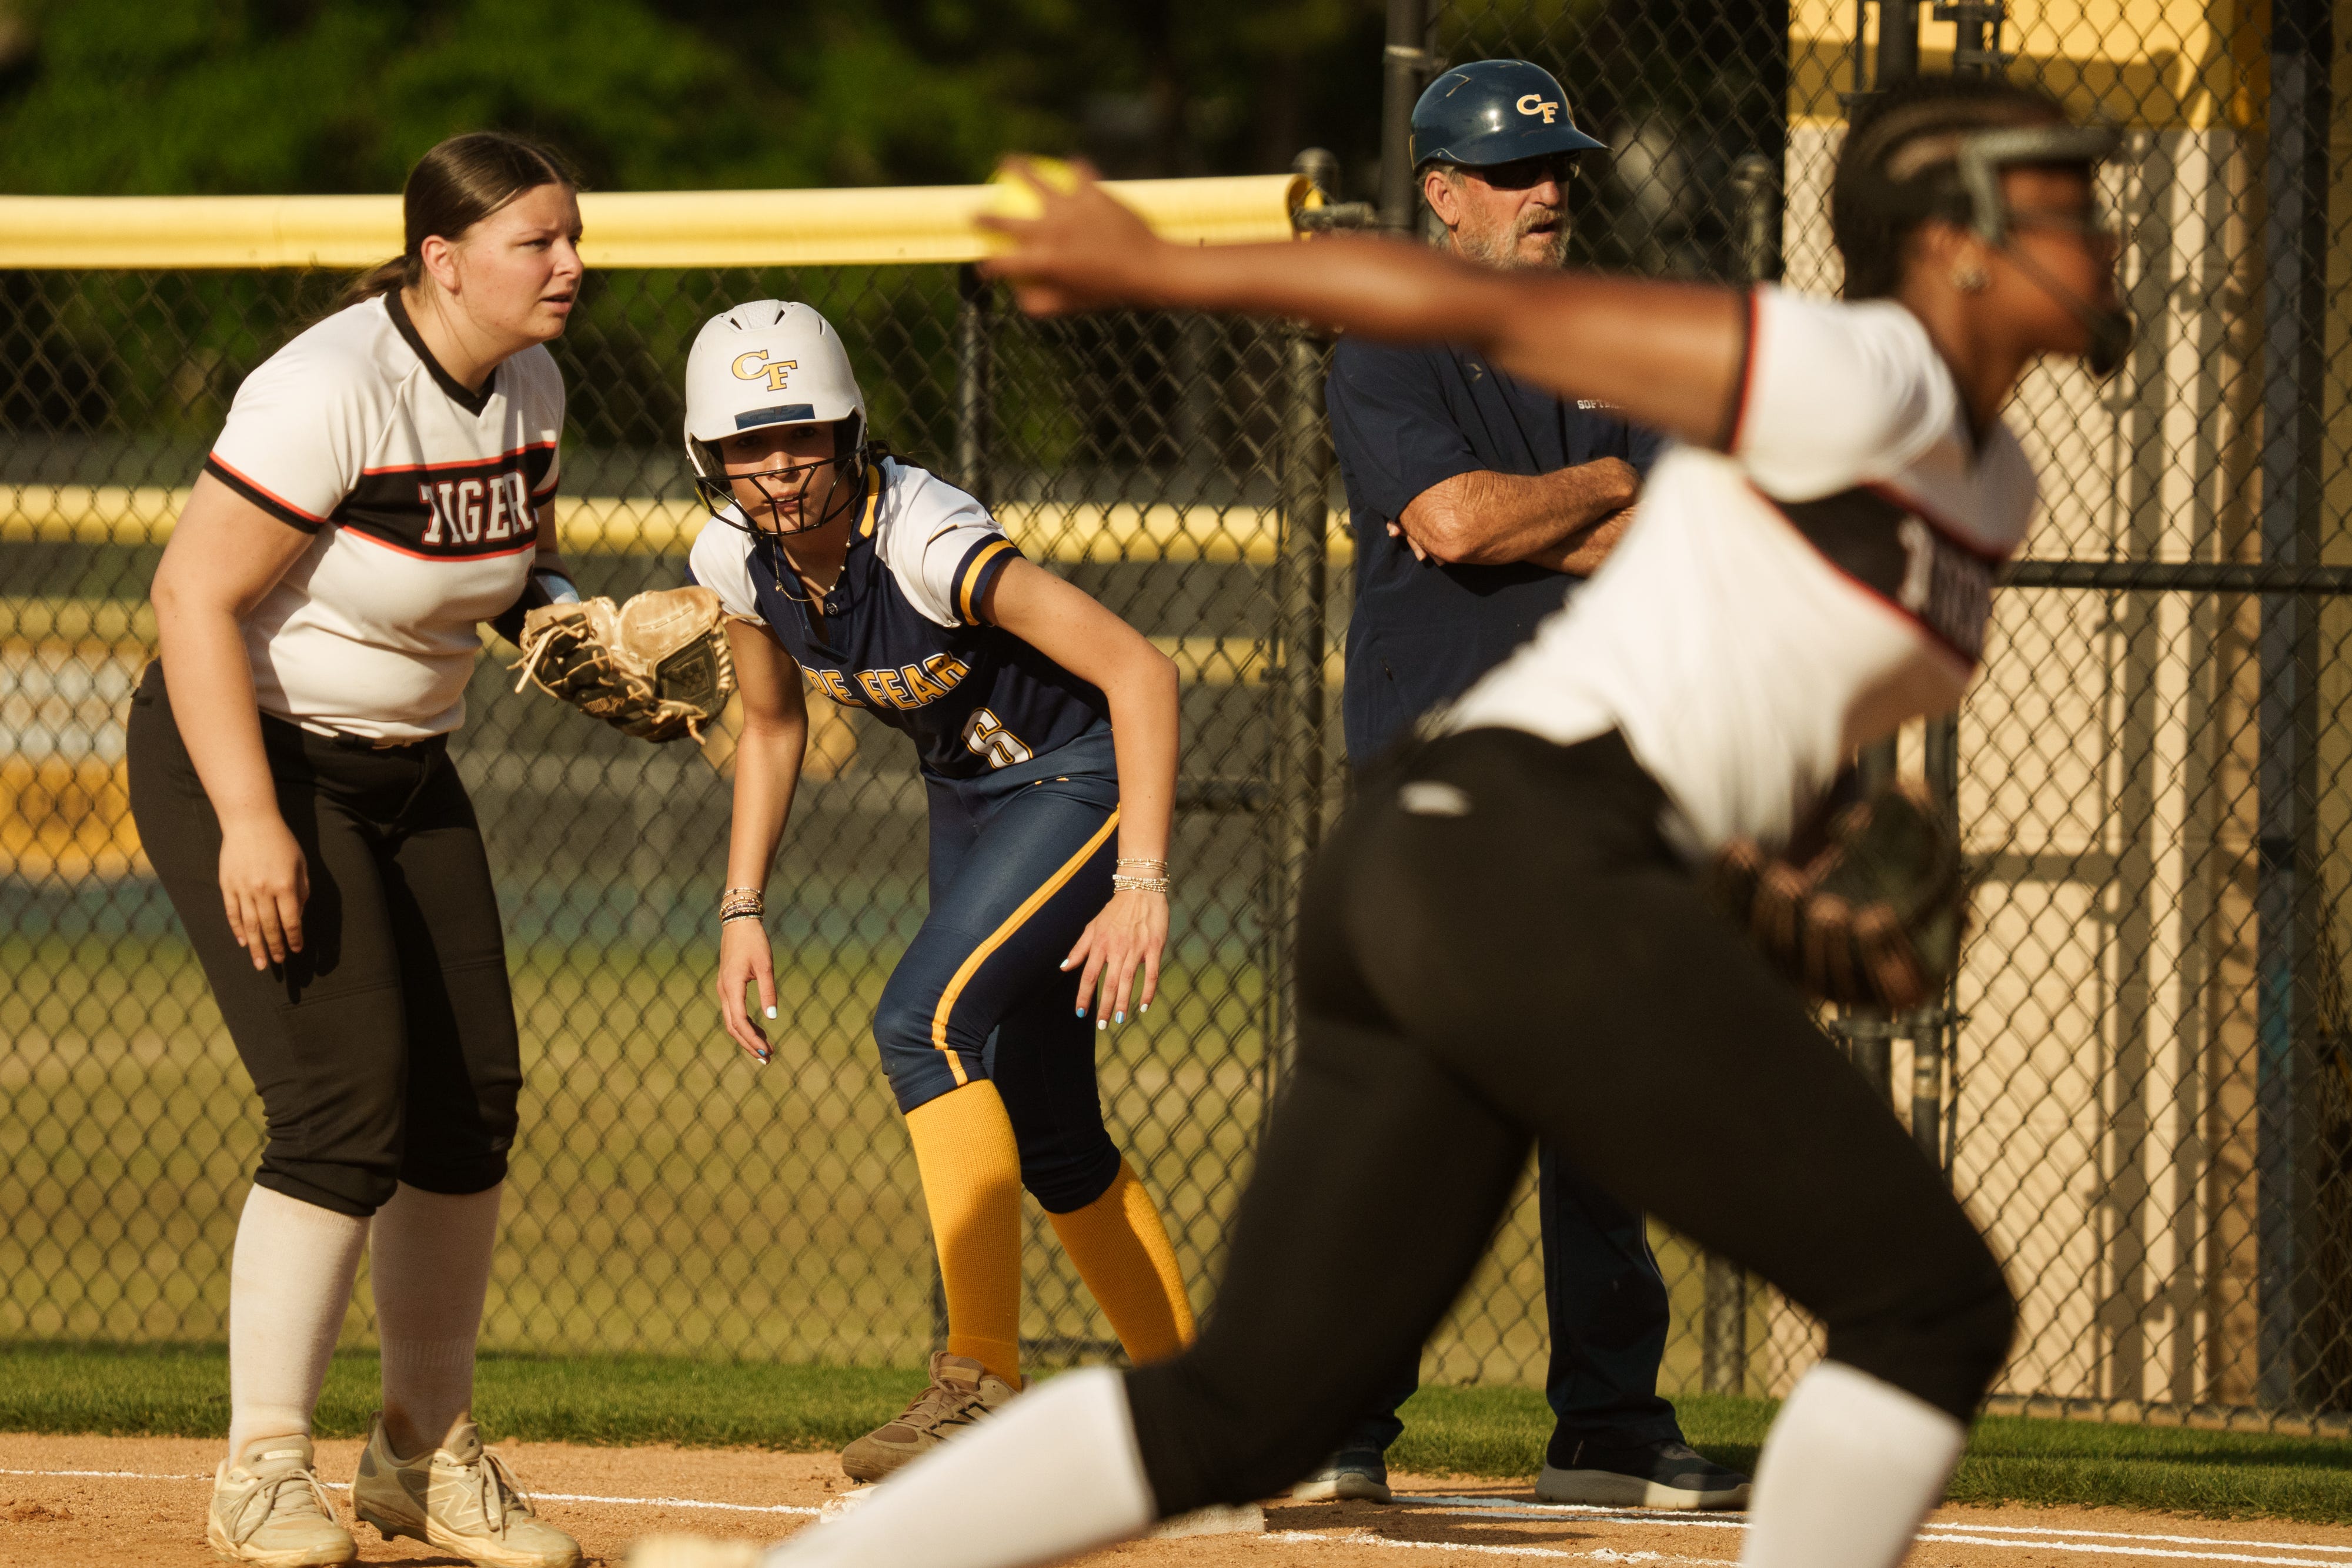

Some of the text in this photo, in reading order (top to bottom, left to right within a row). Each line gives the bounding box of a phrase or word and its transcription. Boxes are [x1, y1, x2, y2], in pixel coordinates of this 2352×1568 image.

[1516, 94, 1559, 123] CF
[731, 349, 798, 392] CF
[418, 469, 539, 547] TIGER
[853, 651, 971, 710] FEAR
[961, 707, 1033, 769] 6
